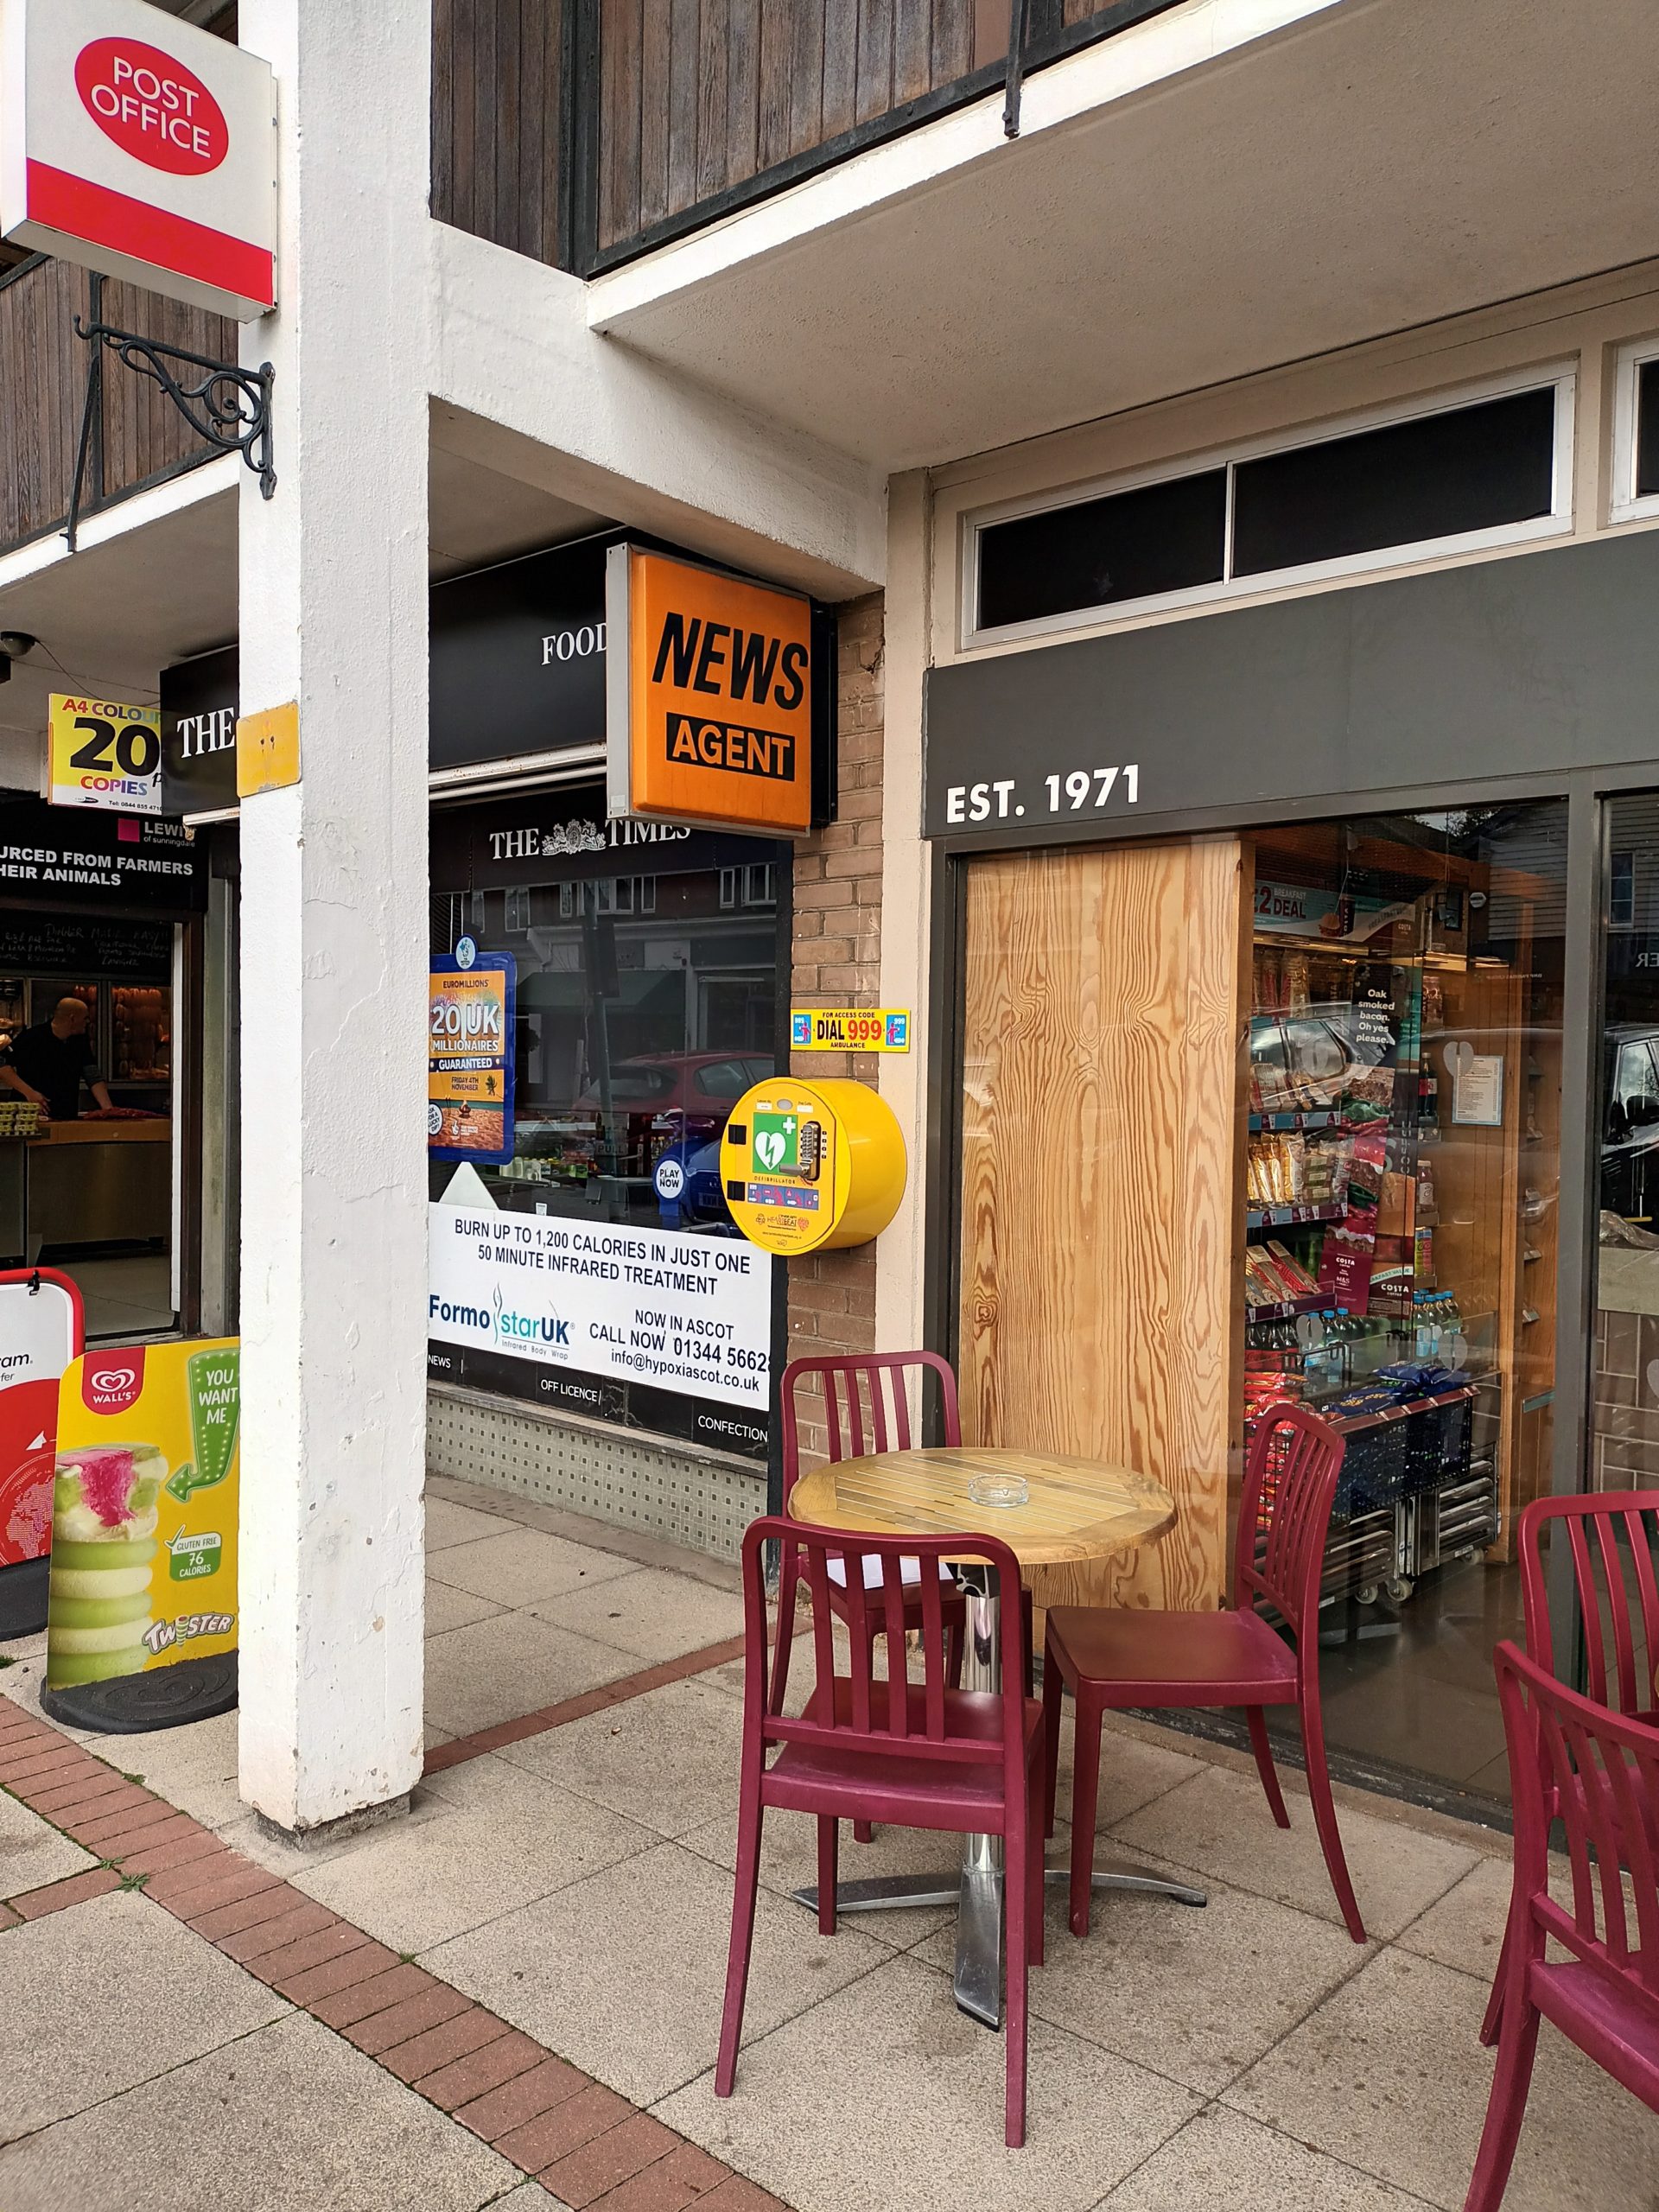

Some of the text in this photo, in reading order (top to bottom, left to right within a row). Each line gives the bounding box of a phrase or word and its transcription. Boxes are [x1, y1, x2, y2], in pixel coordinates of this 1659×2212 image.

[114, 56, 200, 117] POST
[91, 84, 211, 158] OFFICE
[652, 612, 809, 711] NEWS
[62, 698, 88, 715] A4
[177, 707, 235, 759] THE
[70, 716, 161, 778] 20
[672, 720, 791, 776] AGENT
[79, 775, 148, 796] COPIES
[947, 764, 1139, 823] EST. 1971
[143, 822, 195, 838] LEWI
[153, 837, 195, 848] sunningdale
[489, 828, 540, 860] THE
[63, 852, 111, 868] FROM
[117, 857, 194, 875] FARMERS
[42, 868, 121, 886] ANIMALS
[1274, 899, 1306, 918] DEAL
[443, 980, 489, 988] EUROMILLIONS
[1368, 989, 1387, 999] Oak
[1358, 1001, 1395, 1010] smoked
[432, 1003, 499, 1036] 20 UK
[1360, 1011, 1390, 1021] bacon.
[817, 1020, 881, 1041] DIAL 999
[1358, 1022, 1389, 1033] Oh yes
[433, 1039, 499, 1052] MILLIONAIRES
[1356, 1033, 1389, 1044] please.
[439, 1058, 493, 1071] GUARANTEED
[659, 1169, 680, 1179] PLAY
[754, 1176, 796, 1185] DEFIBRILLATOR
[659, 1179, 680, 1188] NOW
[454, 1218, 751, 1274] BURN UP TO 1,200 CALORIES IN JUST ONE
[478, 1244, 717, 1295] 50 MINUTE INFRARED TREATMENT
[1336, 1257, 1355, 1266] COSTA
[1381, 1284, 1409, 1293] COSTA
[429, 1294, 490, 1329] Formo
[635, 1309, 734, 1340] NOW IN ASCOT
[502, 1340, 569, 1360] Infrared Body Wrap
[589, 1322, 771, 1372] CALL NOW 01344 5662
[428, 1355, 451, 1369] NEWS
[611, 1349, 760, 1392] info@hypoxiascot.co.uk
[206, 1369, 234, 1386] YOU
[93, 1392, 132, 1404] WALL'S
[199, 1387, 238, 1407] WANT
[541, 1379, 598, 1402] OFF LICENCE
[207, 1408, 227, 1425] ME
[698, 1415, 768, 1443] CONFECTION
[177, 1537, 217, 1551] GLUTEN FREE
[188, 1551, 204, 1567] 76
[180, 1564, 211, 1577] CALORIES
